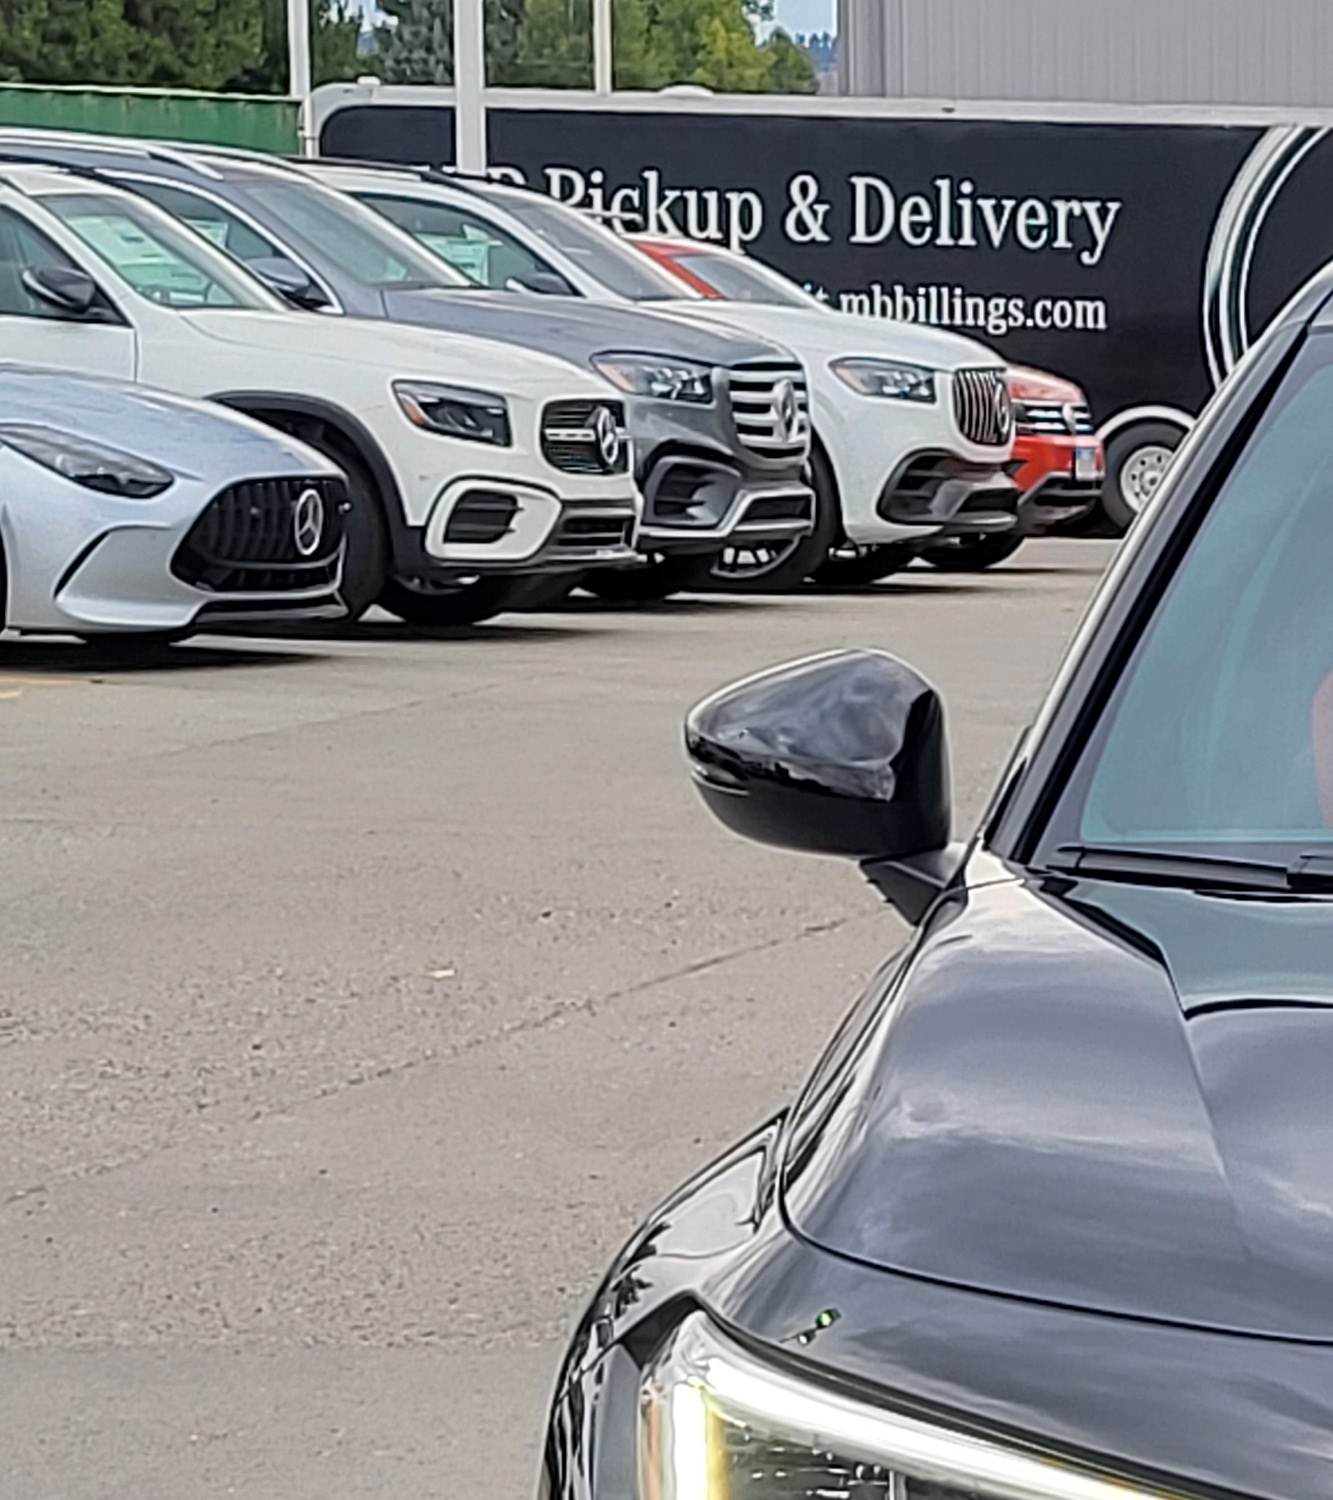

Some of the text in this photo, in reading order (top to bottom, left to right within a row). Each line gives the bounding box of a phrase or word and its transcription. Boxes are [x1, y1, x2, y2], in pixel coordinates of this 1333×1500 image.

[544, 168, 1122, 266] Pickup & Delivery
[839, 284, 1107, 335] mbbillings.com
